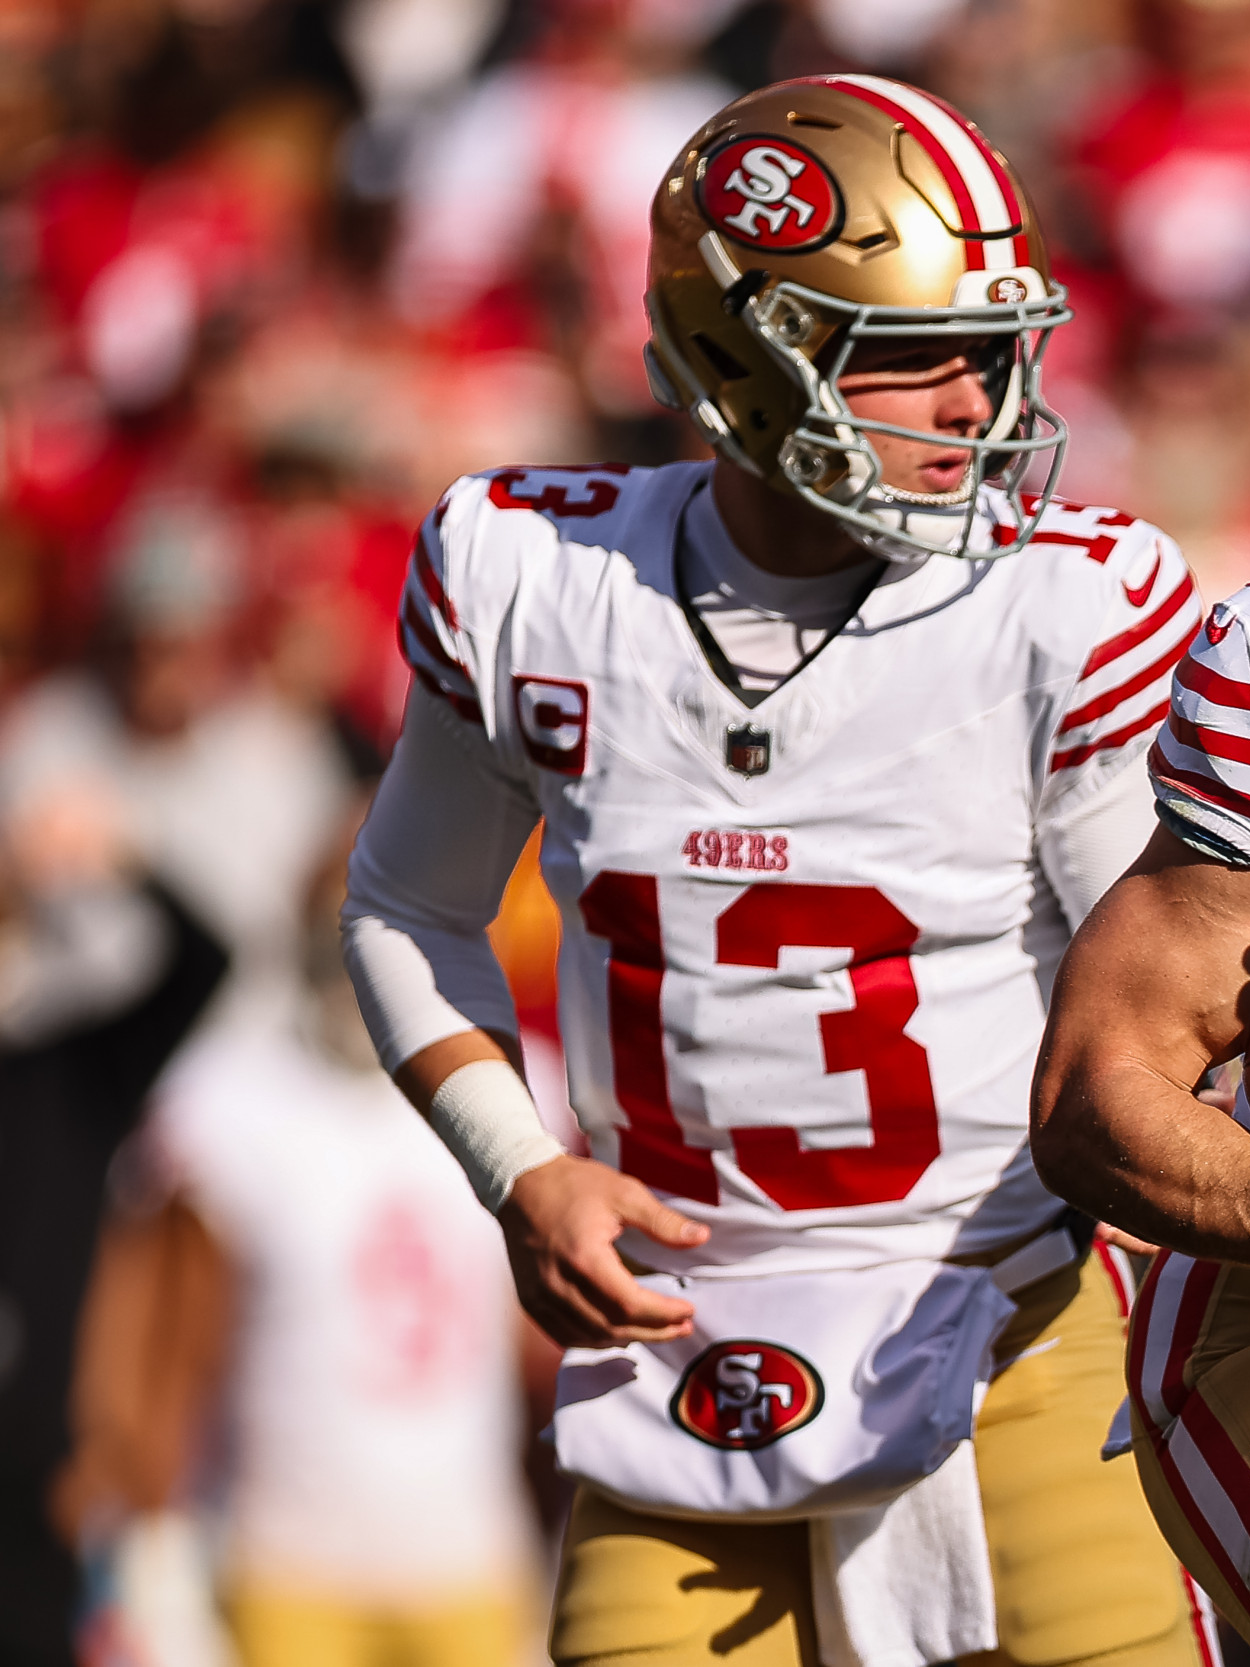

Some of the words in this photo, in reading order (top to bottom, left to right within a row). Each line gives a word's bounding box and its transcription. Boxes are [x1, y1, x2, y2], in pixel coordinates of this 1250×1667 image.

[518, 681, 584, 752] C
[681, 830, 788, 871] 49ERS
[578, 869, 943, 1213] 13
